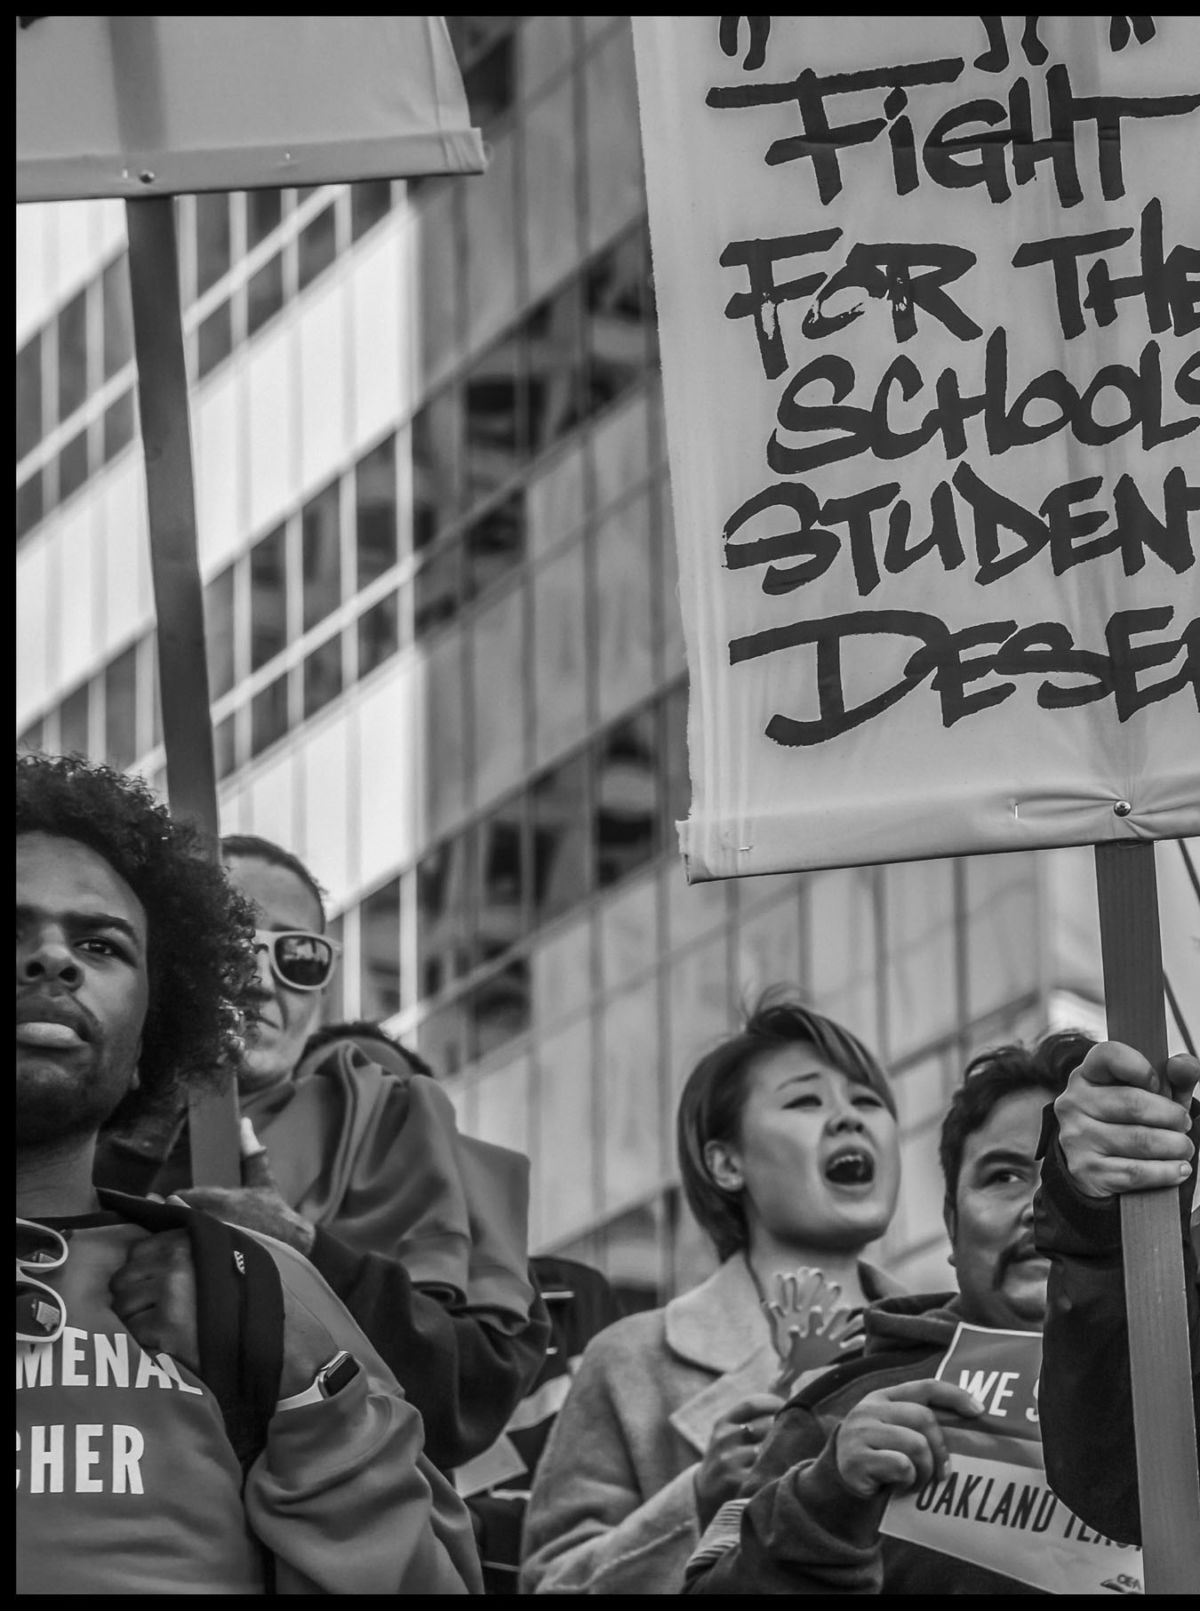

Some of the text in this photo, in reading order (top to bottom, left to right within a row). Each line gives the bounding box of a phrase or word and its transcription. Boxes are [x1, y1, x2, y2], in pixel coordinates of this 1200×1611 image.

[720, 227, 983, 379] FOR
[958, 1369, 1020, 1417] WE
[915, 1471, 1058, 1533] OAKLAND
